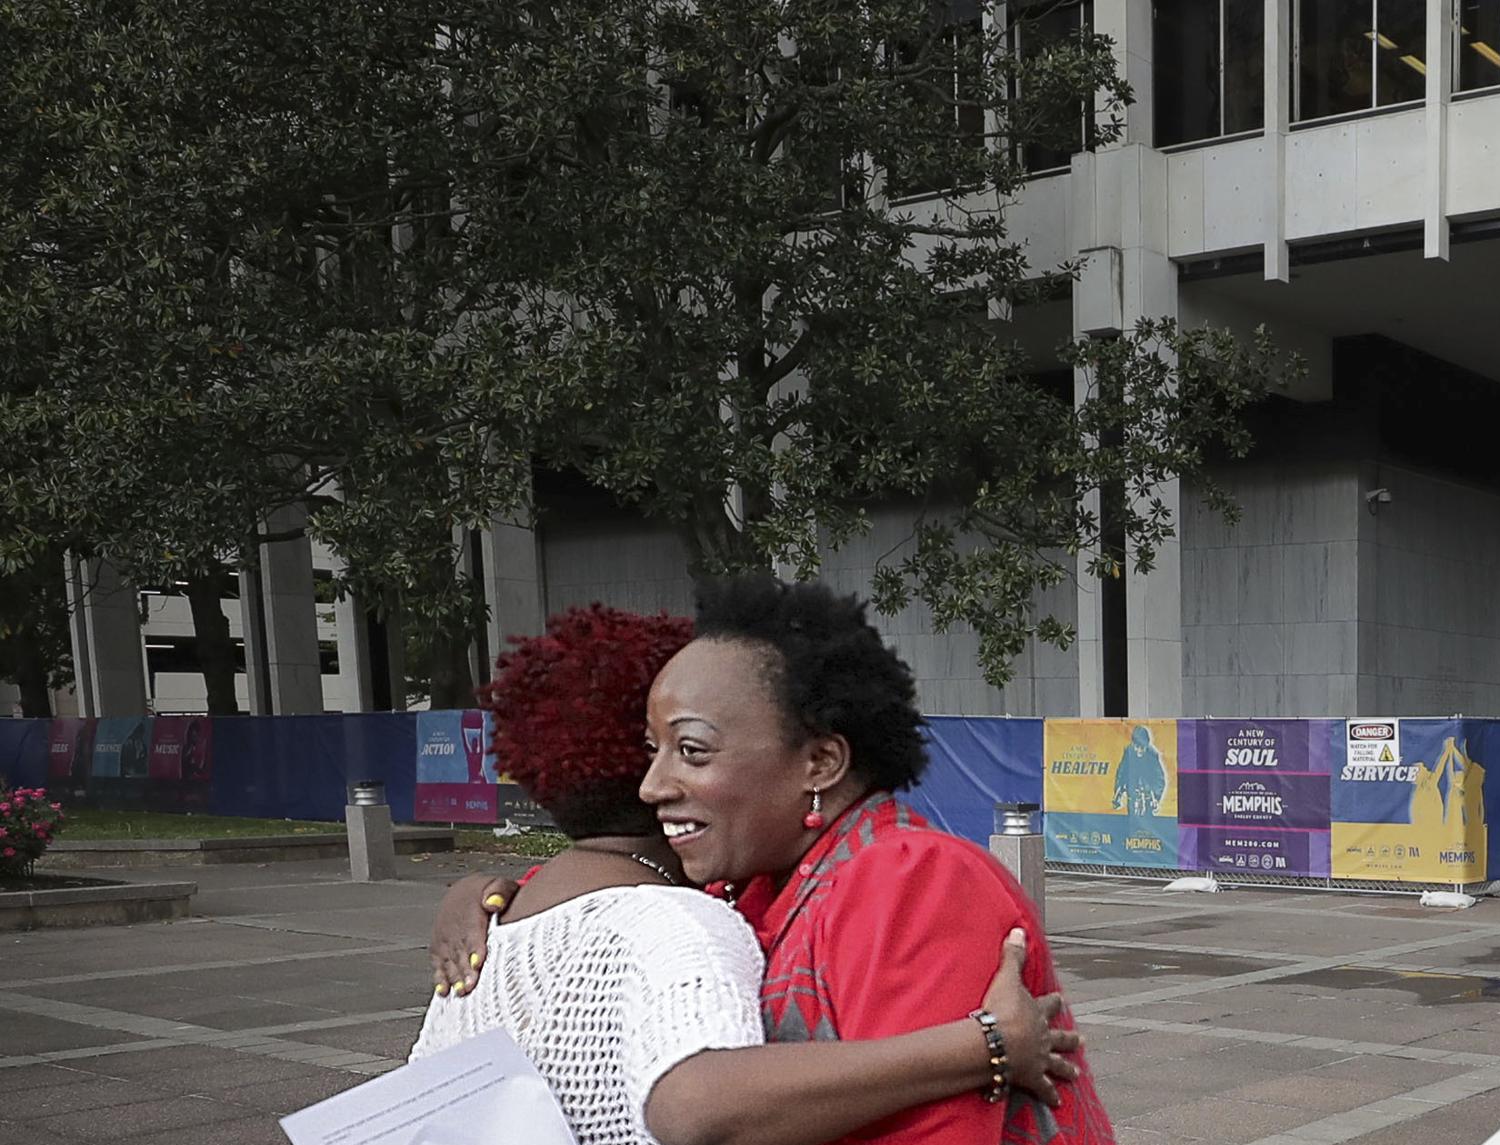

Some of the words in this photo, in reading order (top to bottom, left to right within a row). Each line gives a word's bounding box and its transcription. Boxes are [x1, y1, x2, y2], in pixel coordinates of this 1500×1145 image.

[1238, 729, 1245, 737] A
[1246, 729, 1264, 737] NEW
[1355, 727, 1389, 737] DANGER
[1227, 738, 1262, 746] CENTURY
[1225, 748, 1278, 766] SOUL
[1051, 761, 1110, 775] HEALTH
[1341, 765, 1420, 782] SERVICE
[1223, 795, 1283, 815] MEMPHIS
[1126, 838, 1161, 851] MEMPHIS
